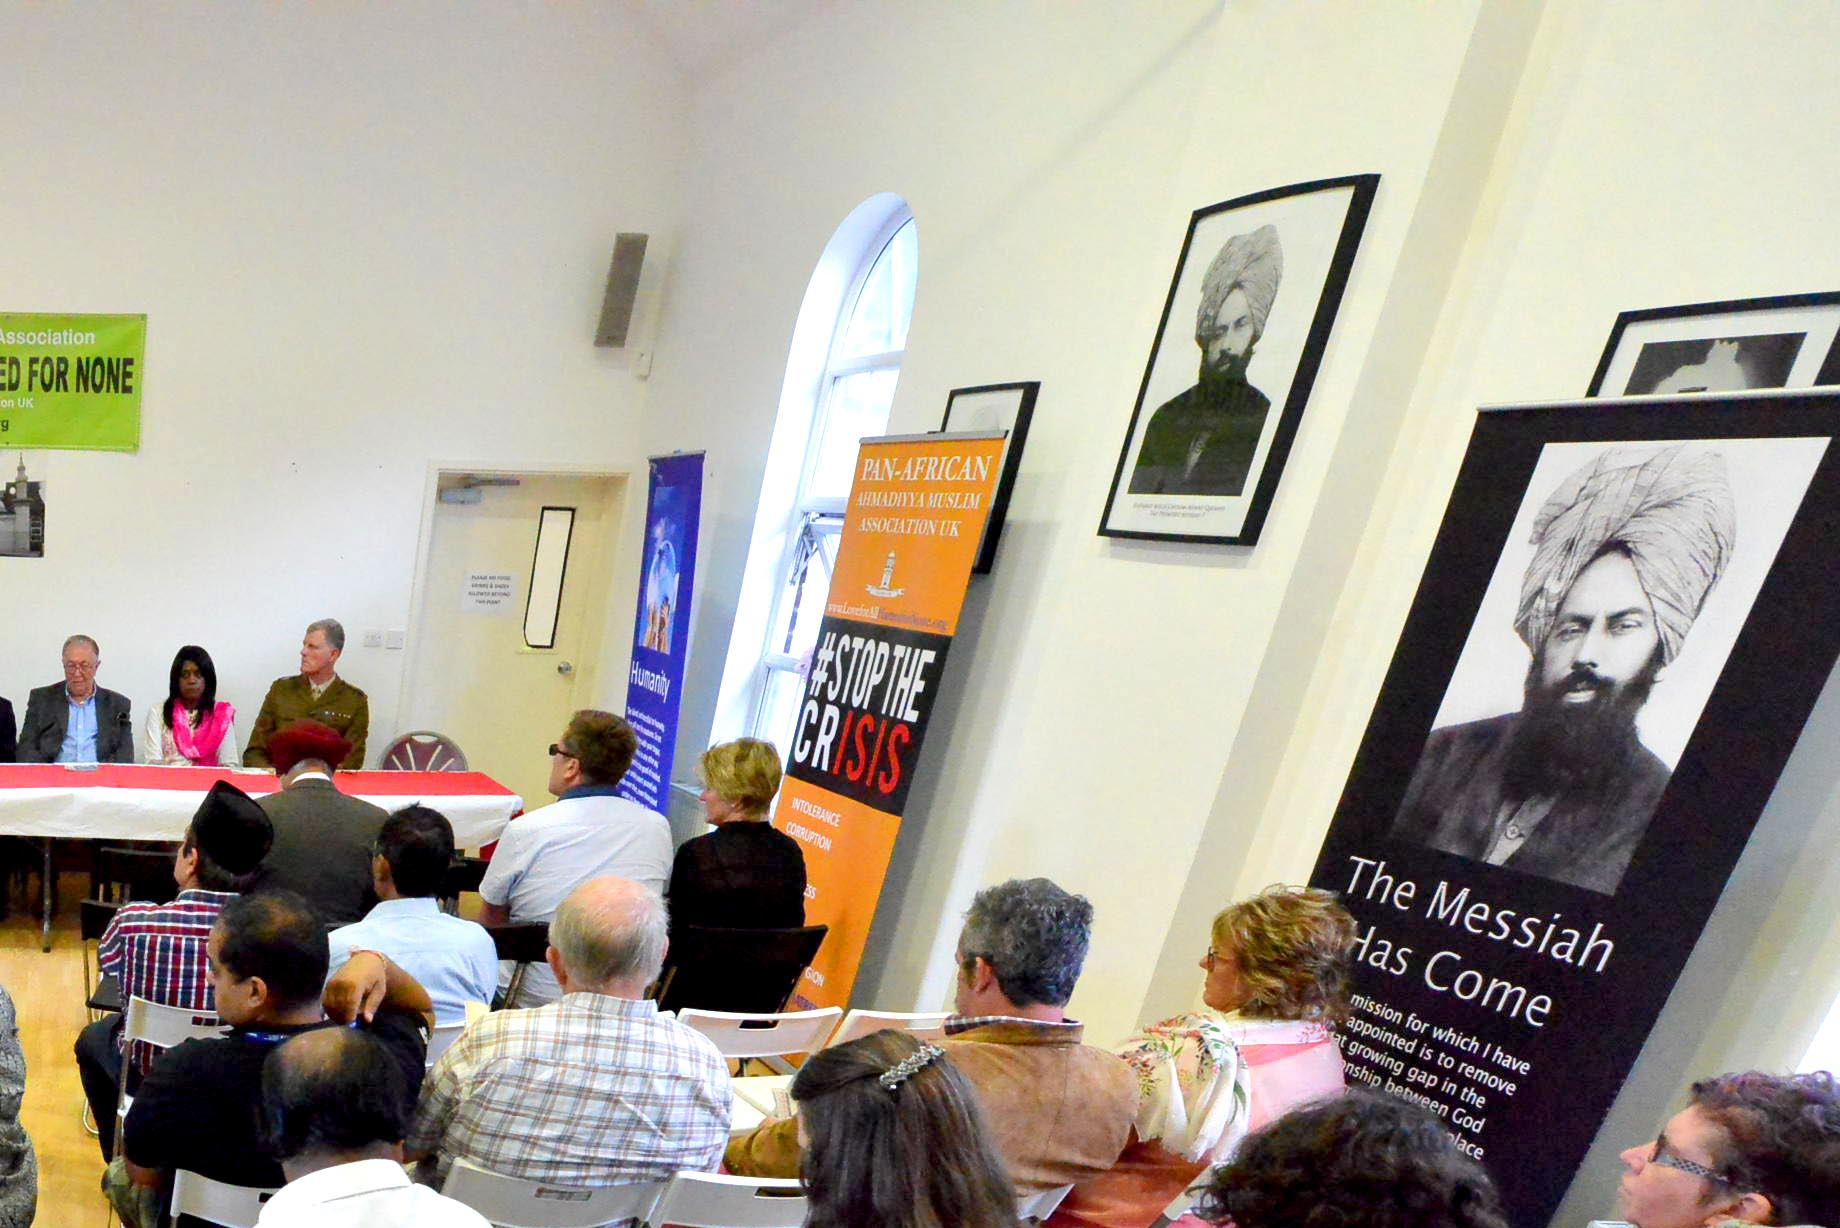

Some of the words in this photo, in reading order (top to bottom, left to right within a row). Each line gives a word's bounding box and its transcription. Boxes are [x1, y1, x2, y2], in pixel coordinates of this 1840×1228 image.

[28, 355, 69, 393] FOR
[75, 357, 135, 395] NONE
[18, 397, 34, 409] UK
[861, 455, 993, 482] PAN-AFRICAN
[856, 490, 925, 509] AHMADIYYA
[928, 492, 984, 510] MUSLIM
[858, 517, 939, 536] ASSOCIATION
[939, 519, 962, 537] UK
[630, 660, 671, 704] Humanity
[810, 631, 890, 711] #STOP
[881, 643, 937, 723] THE
[794, 699, 910, 795] CRISIS
[785, 821, 832, 852] CORRUPTION
[791, 797, 841, 828] INTOLERANCE
[1346, 855, 1417, 911] The
[1425, 880, 1615, 973] Messiah
[1424, 950, 1553, 1028] Come
[1346, 1015, 1418, 1055] appointed
[1419, 1042, 1433, 1060] is
[1437, 1051, 1455, 1070] to
[1458, 1061, 1517, 1097] remove
[1350, 993, 1404, 1025] mission
[1405, 1012, 1431, 1034] for
[1432, 1025, 1480, 1054] which
[1482, 1042, 1492, 1058] I
[1492, 1046, 1532, 1075] have
[1348, 1039, 1405, 1076] growing
[1406, 1065, 1439, 1089] gap
[1441, 1076, 1458, 1097] in
[1460, 1085, 1487, 1110] the
[1384, 1076, 1450, 1118] between
[1451, 1107, 1487, 1134] God
